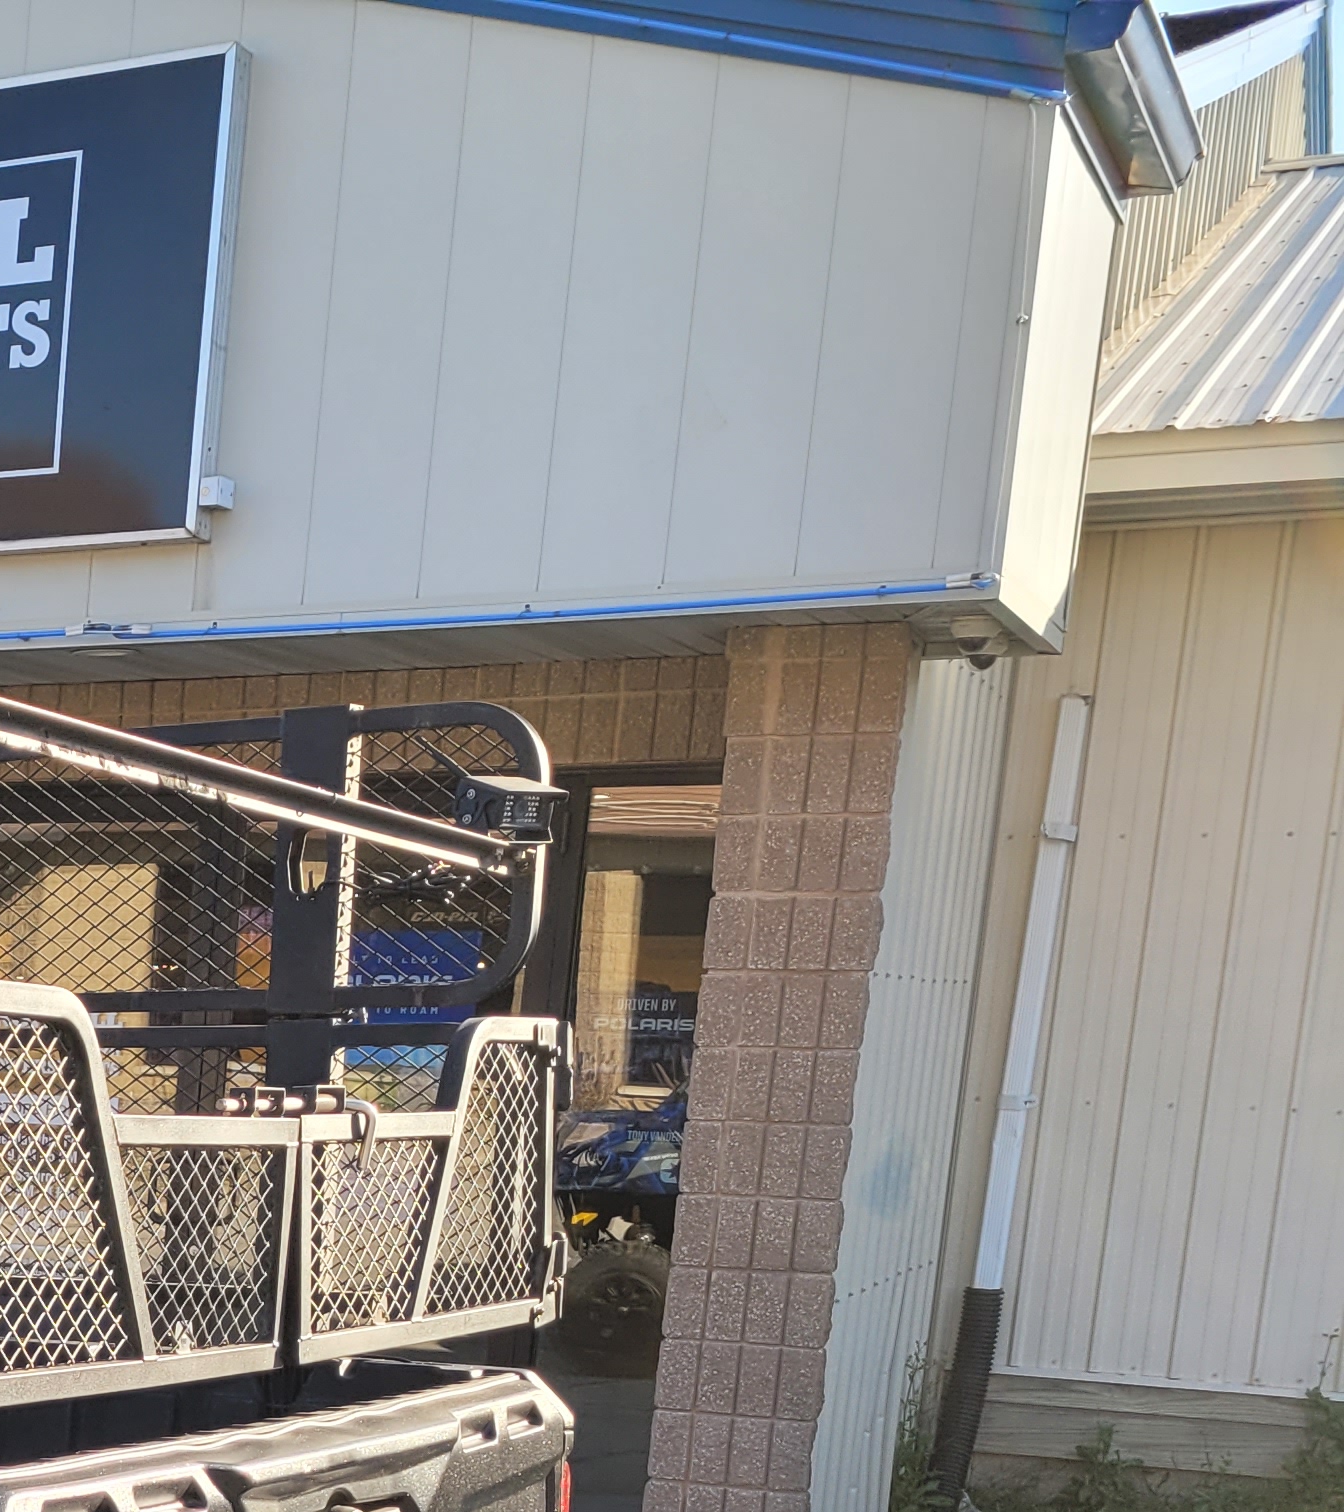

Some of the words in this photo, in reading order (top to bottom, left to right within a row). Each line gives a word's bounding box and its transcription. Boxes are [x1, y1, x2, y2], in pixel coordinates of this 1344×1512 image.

[399, 1006, 439, 1015] ROAM
[617, 998, 659, 1011] DRIVEN
[661, 998, 677, 1011] BY
[593, 1018, 695, 1031] POLARIS
[627, 1130, 650, 1141] TONY
